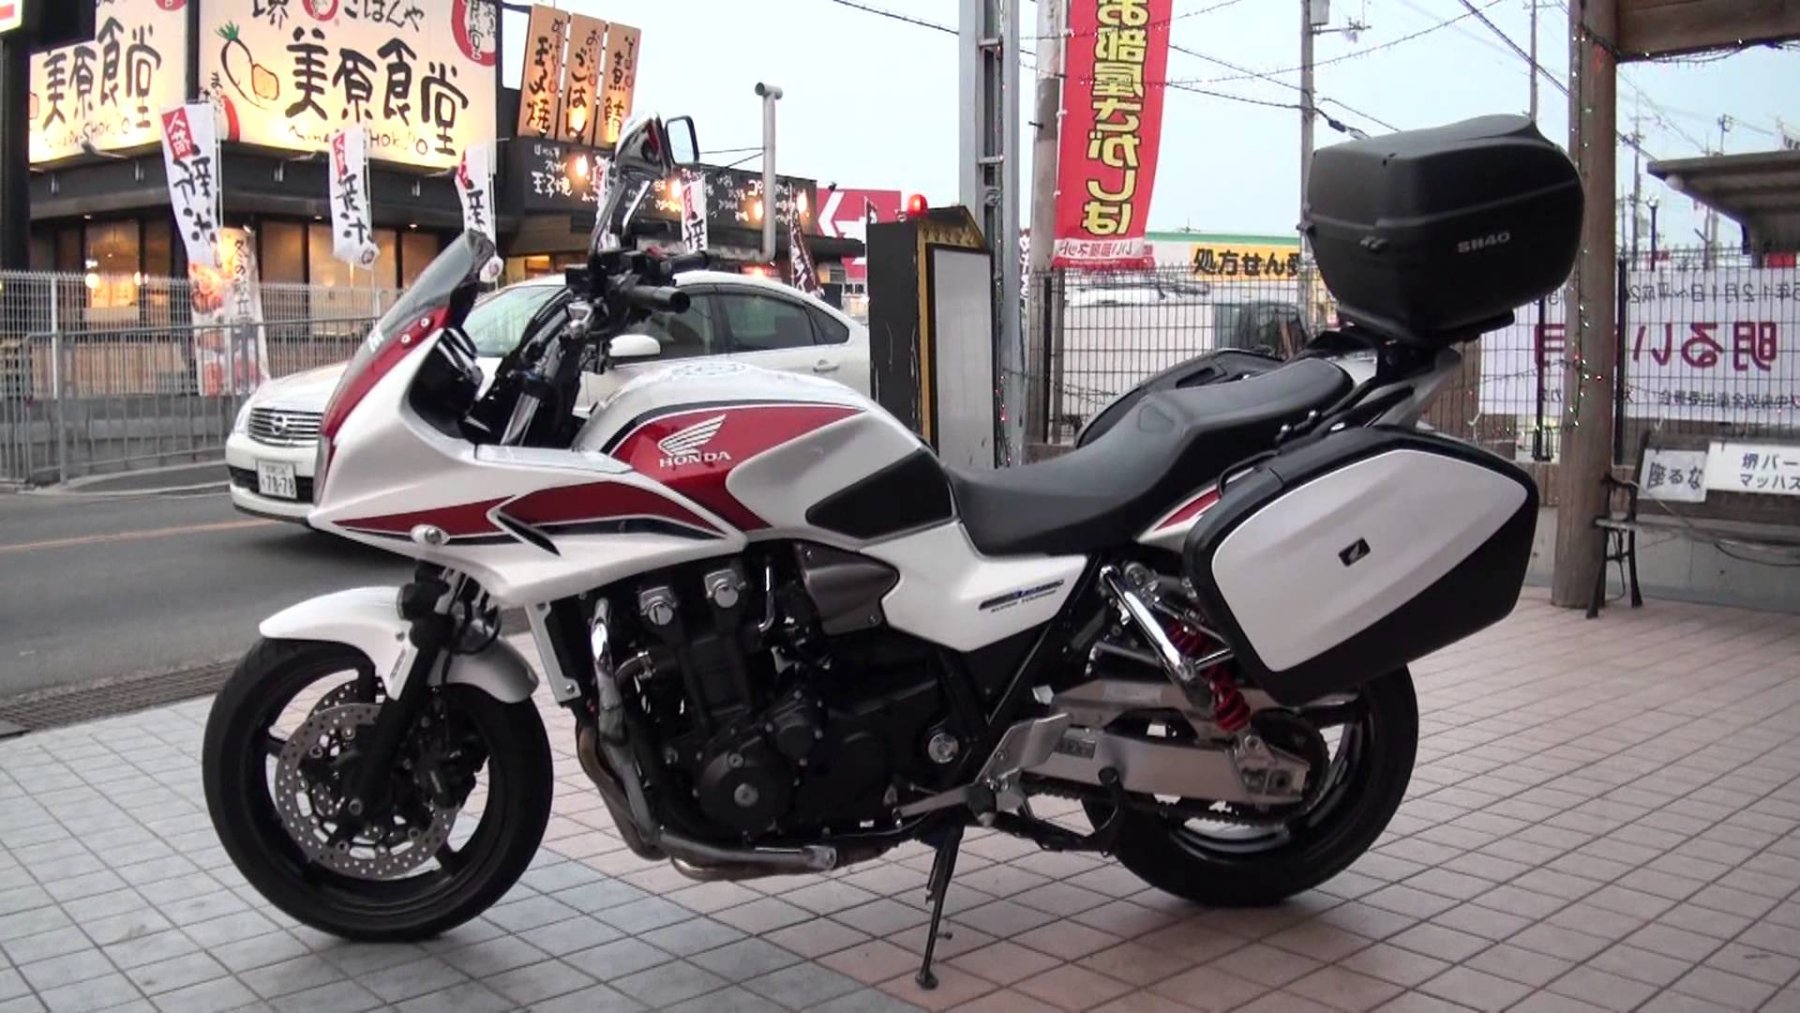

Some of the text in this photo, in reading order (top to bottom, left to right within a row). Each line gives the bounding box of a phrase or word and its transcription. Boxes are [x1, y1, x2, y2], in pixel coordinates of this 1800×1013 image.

[43, 16, 162, 131] 美原食堂
[285, 26, 469, 156] 美原食堂
[659, 451, 731, 467] HONDA
